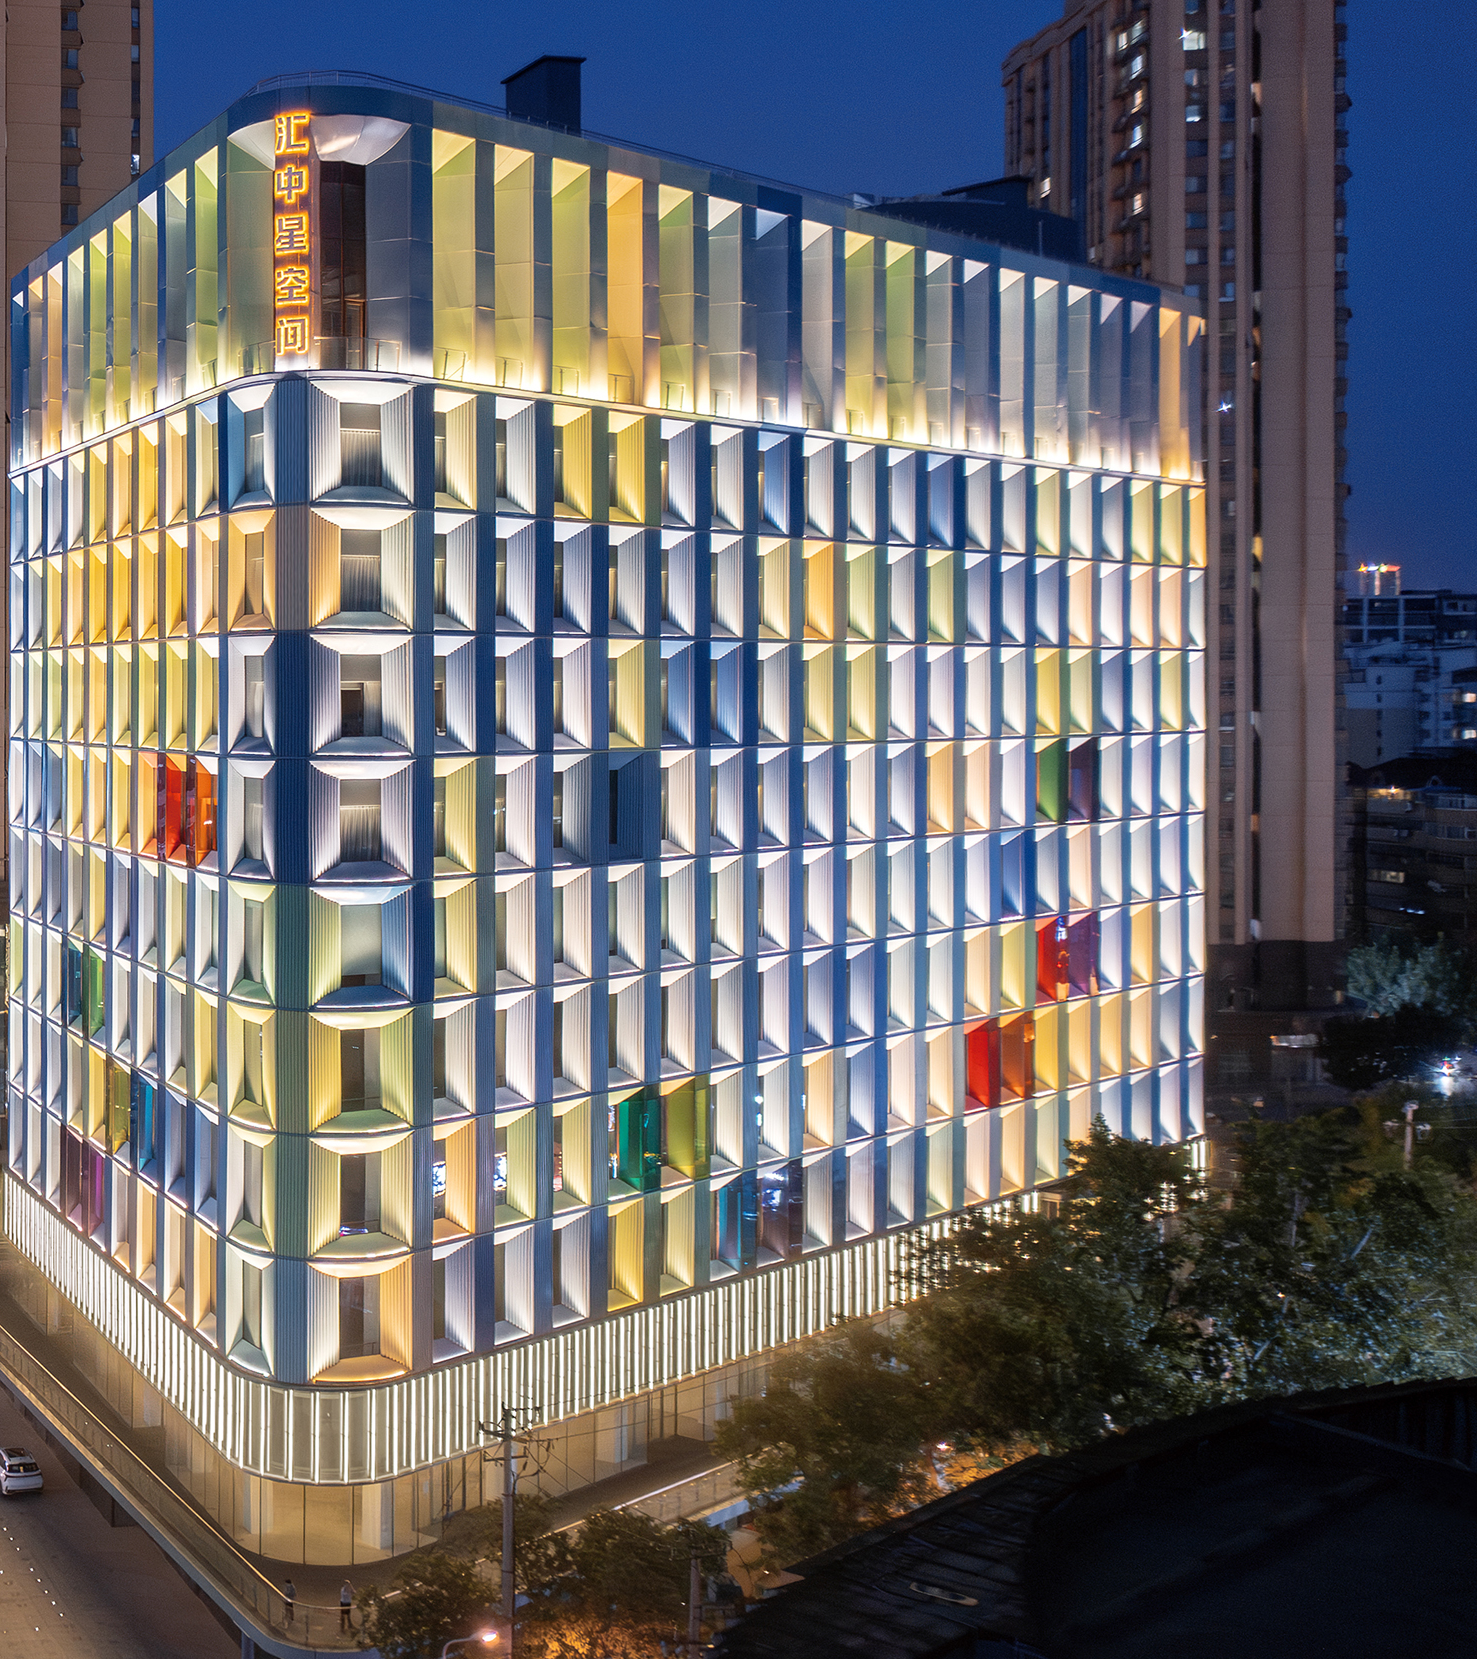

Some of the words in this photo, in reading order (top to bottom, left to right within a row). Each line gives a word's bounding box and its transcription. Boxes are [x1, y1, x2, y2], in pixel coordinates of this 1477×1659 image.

[275, 112, 310, 355] 汇中星空间
